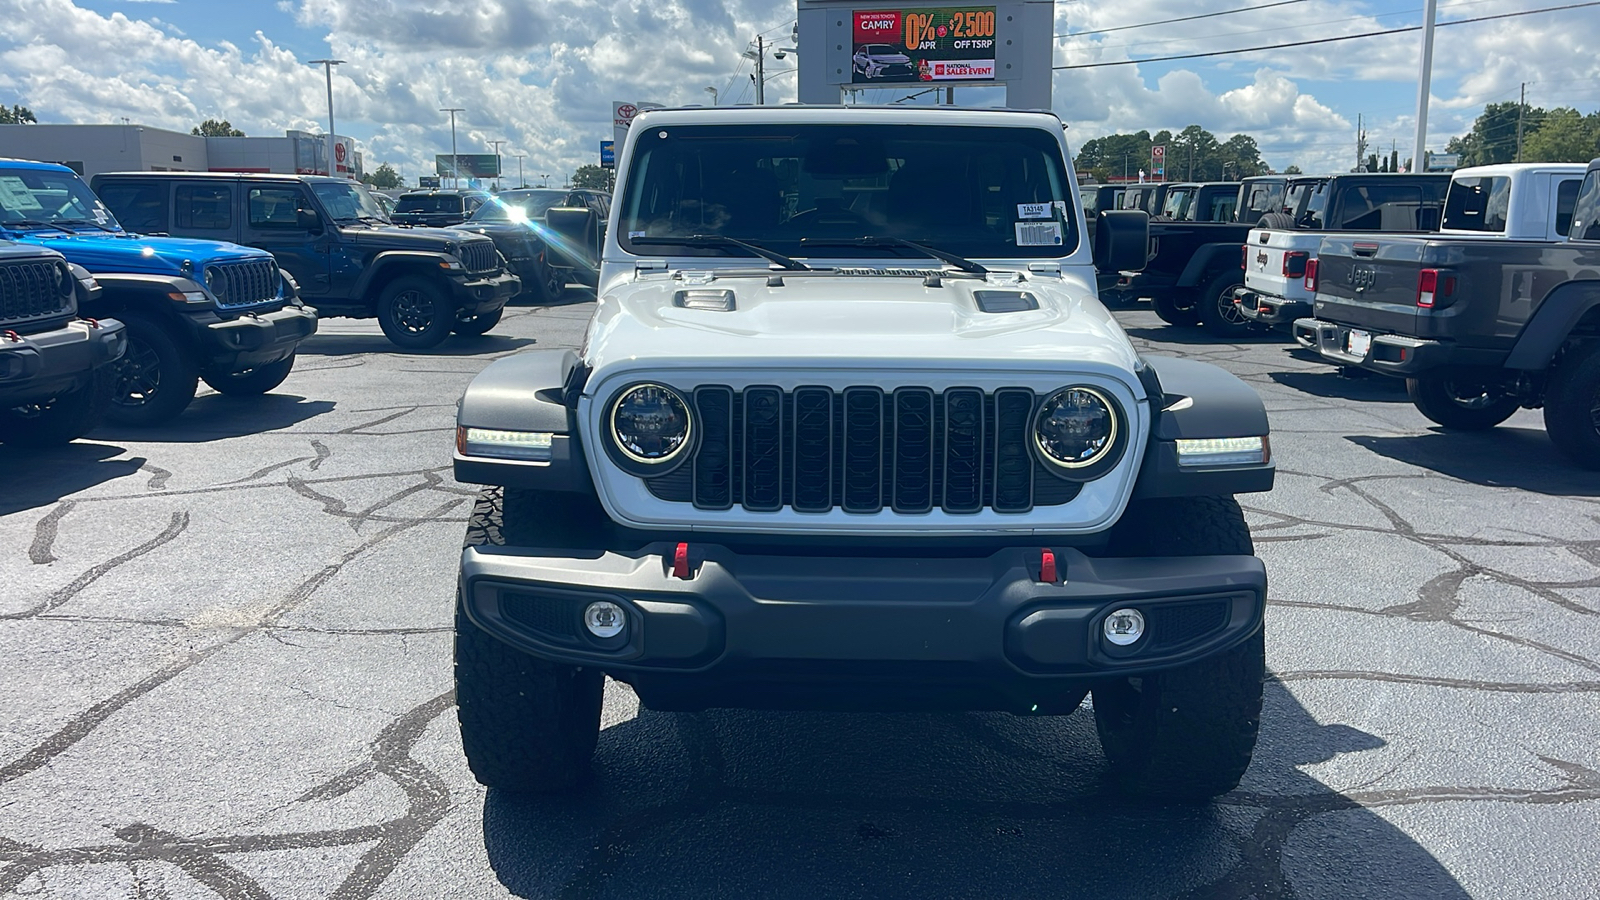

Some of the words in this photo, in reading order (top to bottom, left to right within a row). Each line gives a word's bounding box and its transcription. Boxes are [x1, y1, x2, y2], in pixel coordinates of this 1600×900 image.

[861, 20, 894, 30] CAMRY
[949, 11, 994, 38] $2,500
[905, 13, 935, 50] 0%
[919, 41, 936, 50] APR
[954, 40, 970, 49] OFF
[971, 39, 993, 49] TSRP
[968, 67, 991, 75] EVENT
[1347, 264, 1376, 289] Jeep
